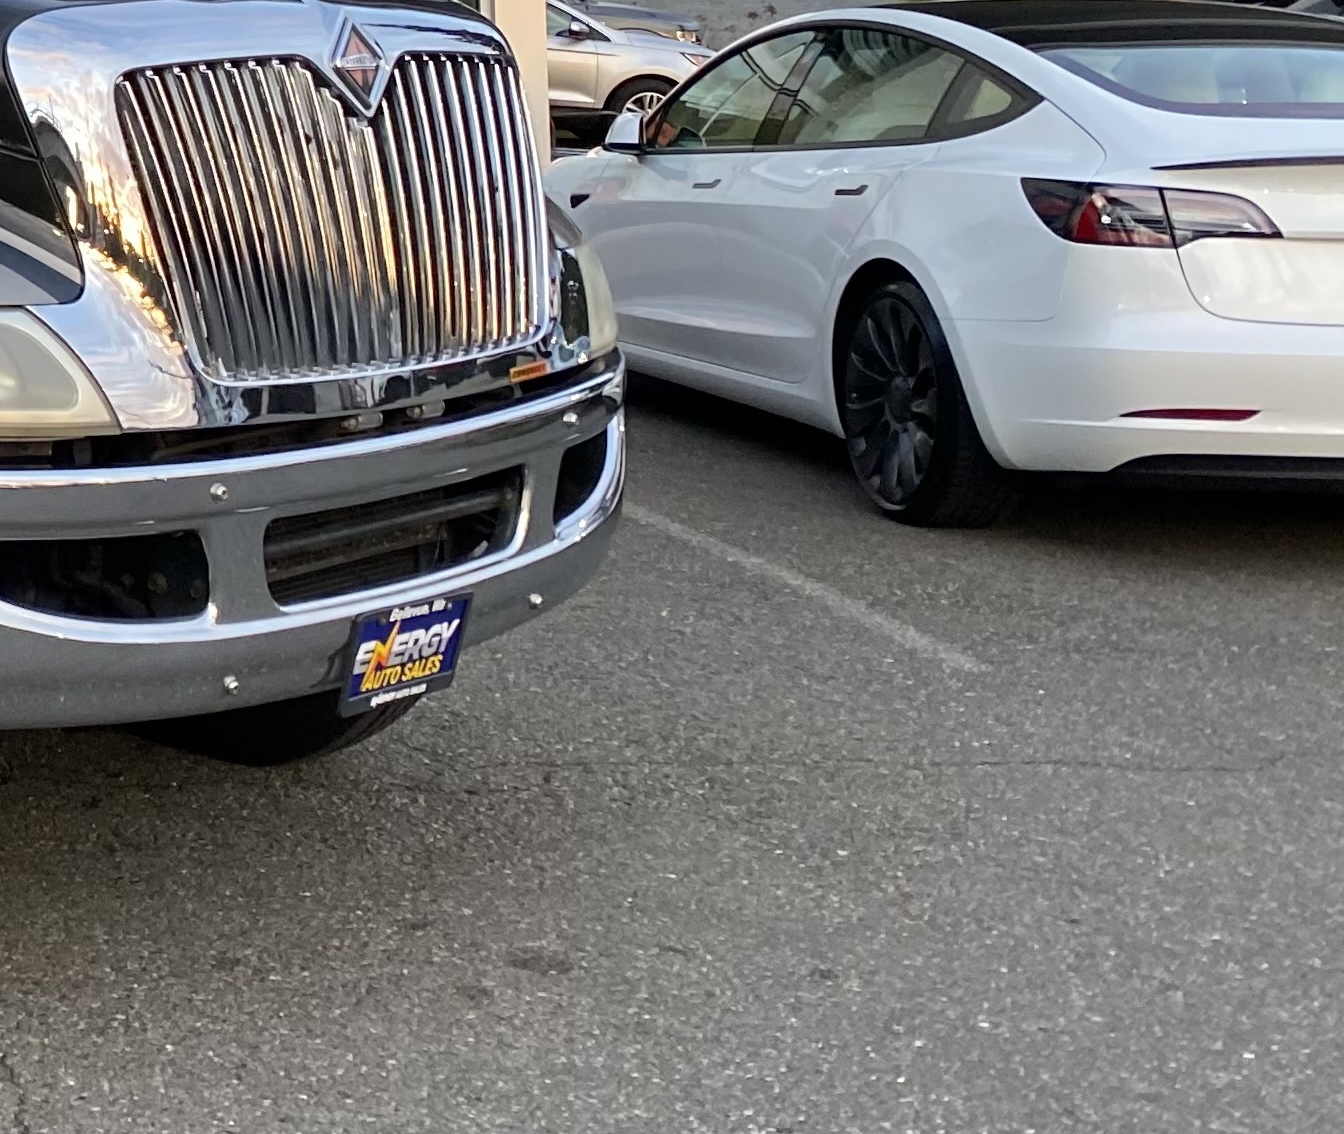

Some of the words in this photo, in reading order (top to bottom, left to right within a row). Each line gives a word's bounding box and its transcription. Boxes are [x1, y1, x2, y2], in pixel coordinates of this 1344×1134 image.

[352, 619, 461, 677] ENERGY
[362, 666, 401, 691] AUTO
[401, 654, 443, 681] SALES
